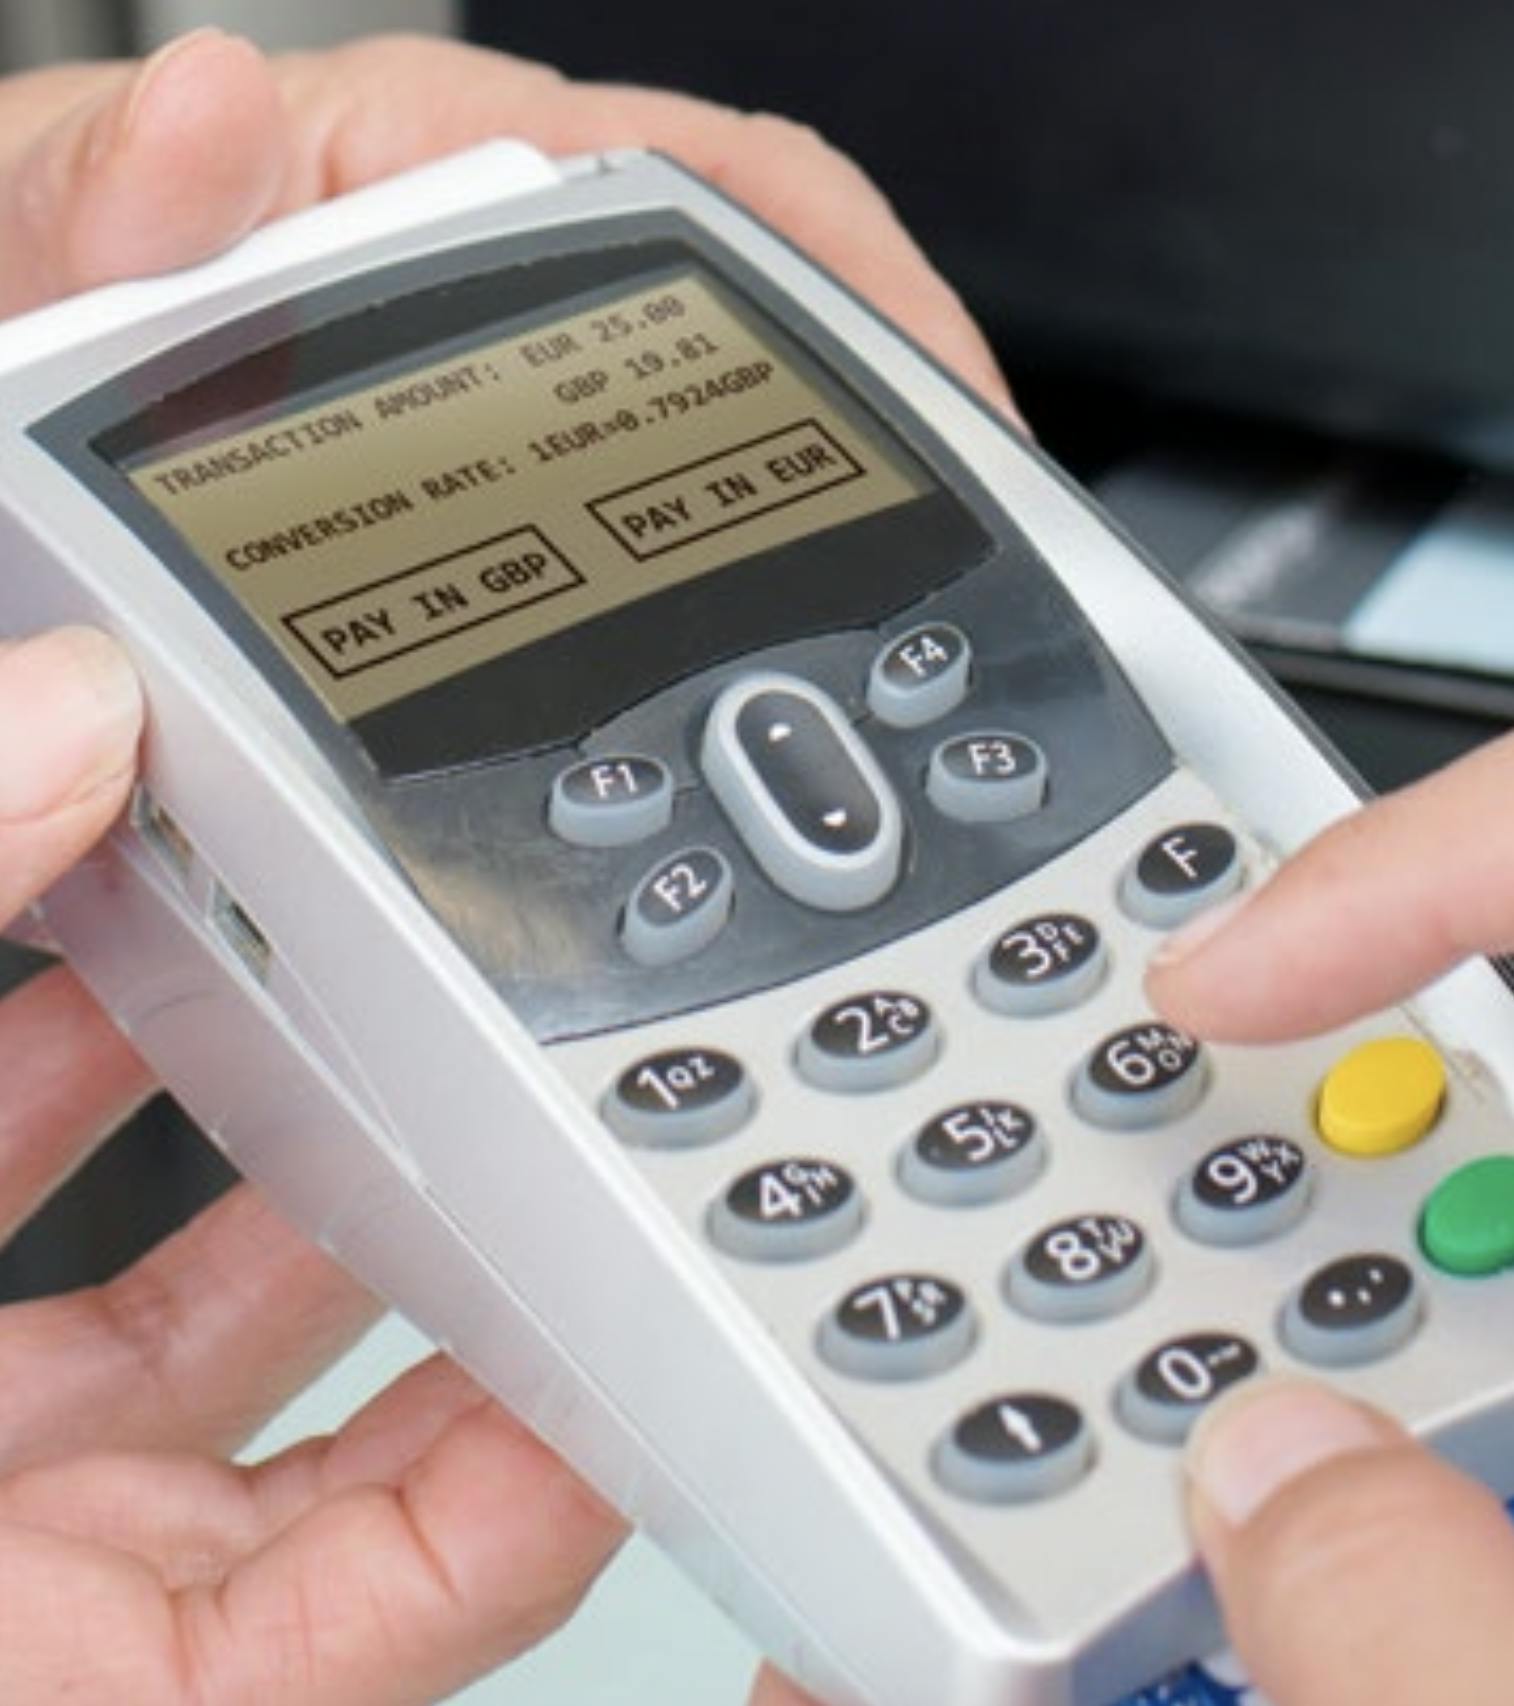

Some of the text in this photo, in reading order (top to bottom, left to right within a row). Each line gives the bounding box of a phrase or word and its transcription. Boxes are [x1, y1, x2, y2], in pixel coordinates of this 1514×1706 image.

[154, 294, 686, 495] TRANSACTION AMOUNT: EUR 25.00
[554, 332, 719, 404] GBP 19.81
[225, 490, 413, 571] CONVERSION
[421, 457, 516, 501] RATE:
[621, 444, 838, 539] PAY IN EUR
[322, 552, 550, 656] PAY IN GBP
[899, 637, 949, 680] F4
[590, 763, 637, 800] F1
[967, 734, 1017, 776] F3
[653, 862, 708, 914] F2
[1161, 835, 1199, 879] F
